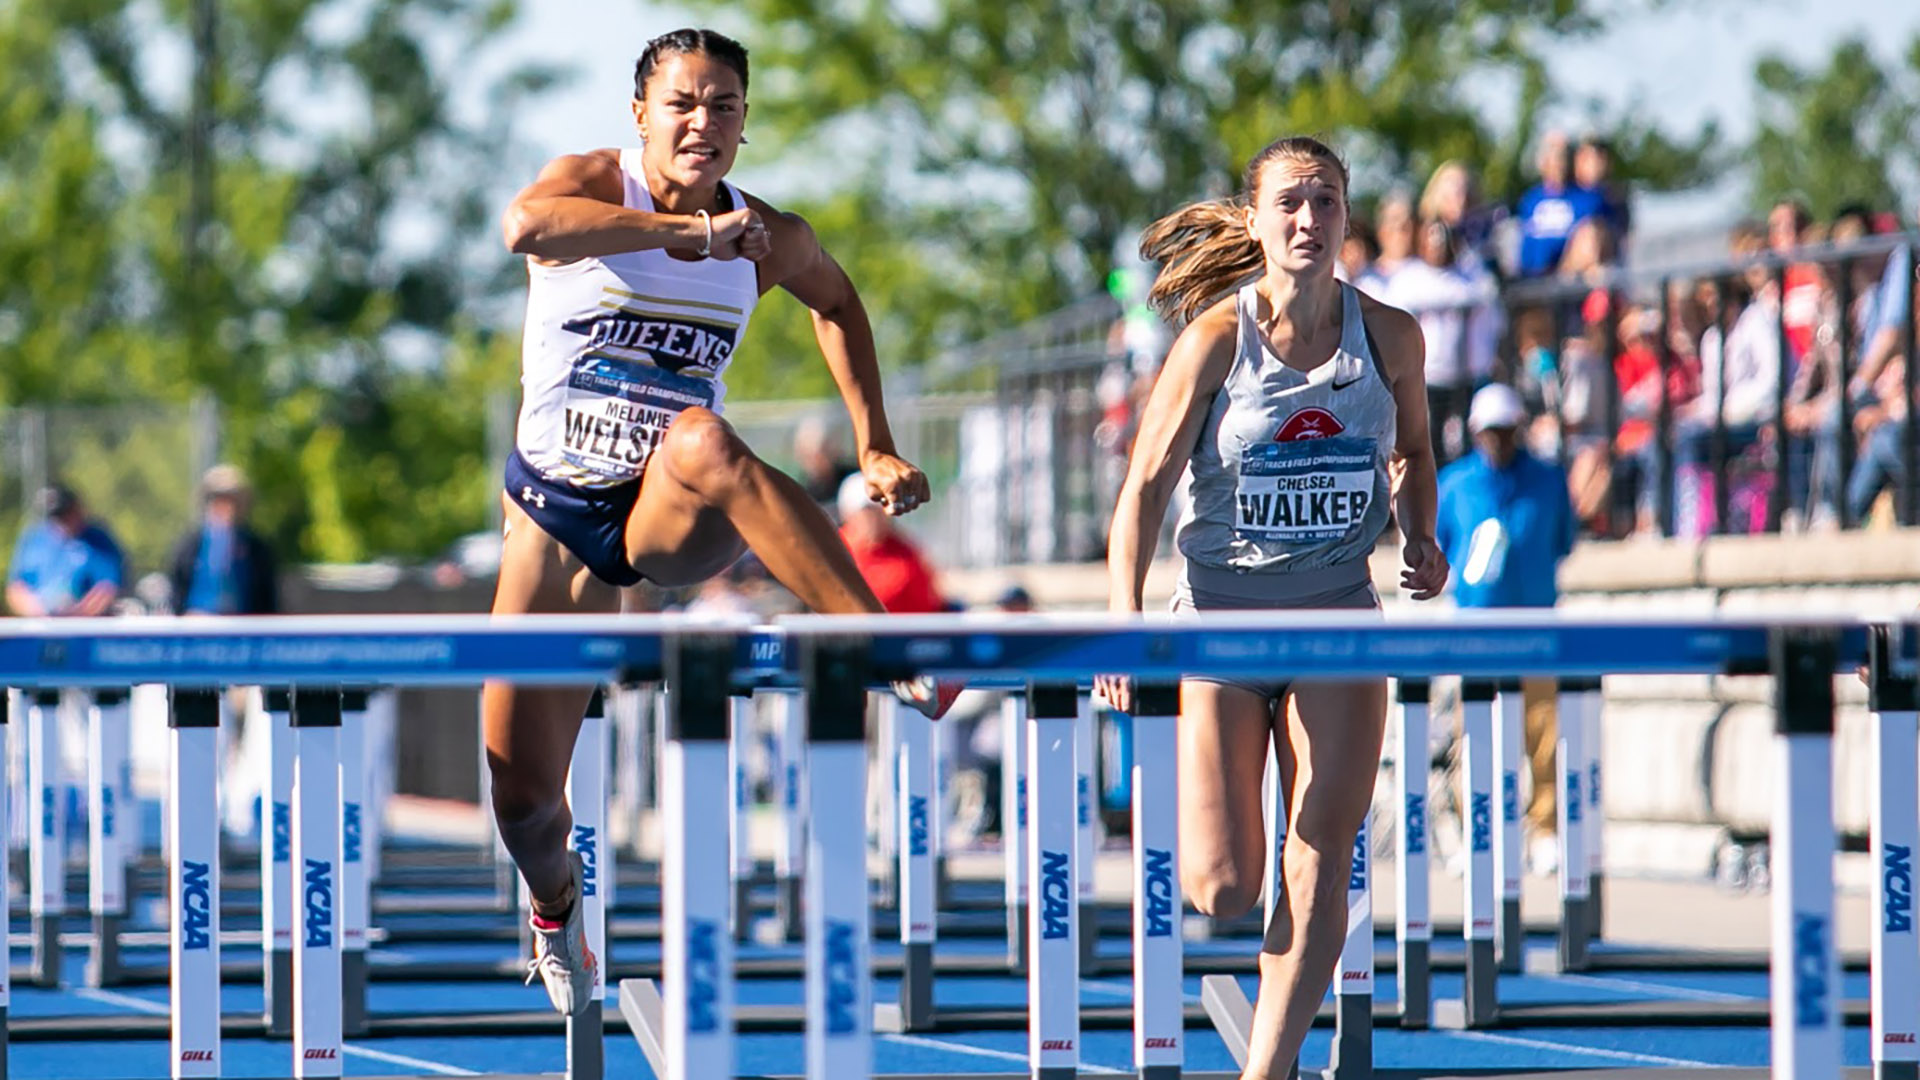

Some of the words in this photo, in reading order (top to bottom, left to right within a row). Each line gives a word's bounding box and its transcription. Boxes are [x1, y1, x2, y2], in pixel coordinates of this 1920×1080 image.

[589, 318, 731, 370] QUEENS
[605, 401, 671, 429] MELANIE
[1277, 475, 1335, 491] CHELSEA
[1042, 850, 1069, 940] NCAA
[1146, 848, 1173, 938] NCAA
[1885, 842, 1912, 934] NCAA
[183, 860, 209, 950] NCAA
[305, 858, 332, 948] NCAA
[1343, 971, 1369, 980] GILL
[1042, 1040, 1073, 1051] GILL
[1145, 1038, 1177, 1049] GILL
[1884, 1033, 1916, 1044] GILL
[181, 1050, 213, 1061] GILL
[304, 1048, 336, 1059] GILL
